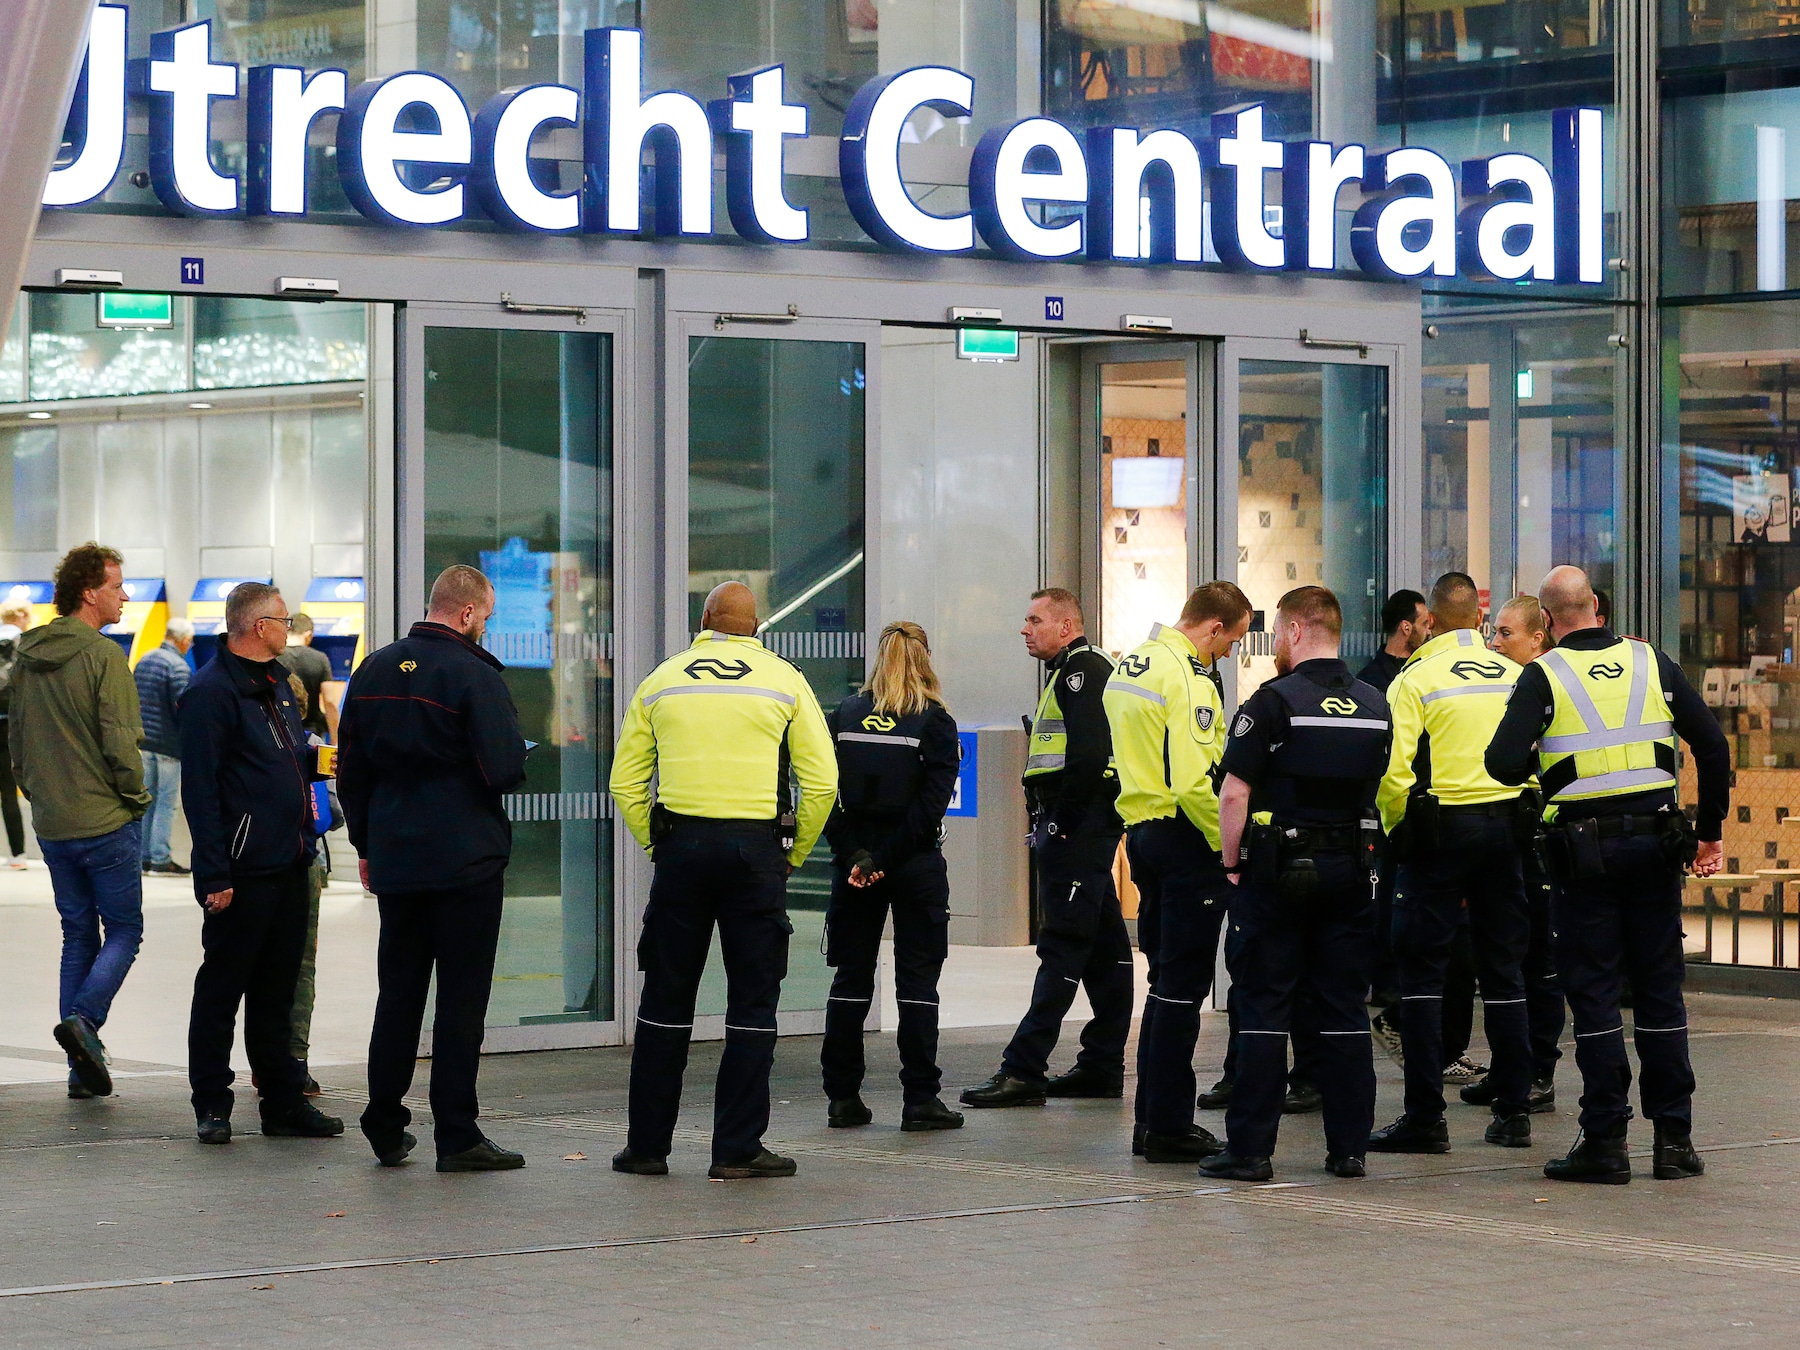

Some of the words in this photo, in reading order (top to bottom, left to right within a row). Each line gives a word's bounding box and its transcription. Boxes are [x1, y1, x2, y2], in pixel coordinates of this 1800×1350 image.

[863, 67, 1603, 283] Centraal
[184, 262, 200, 280] 11
[1047, 300, 1062, 317] 10
[310, 783, 320, 821] OOR
